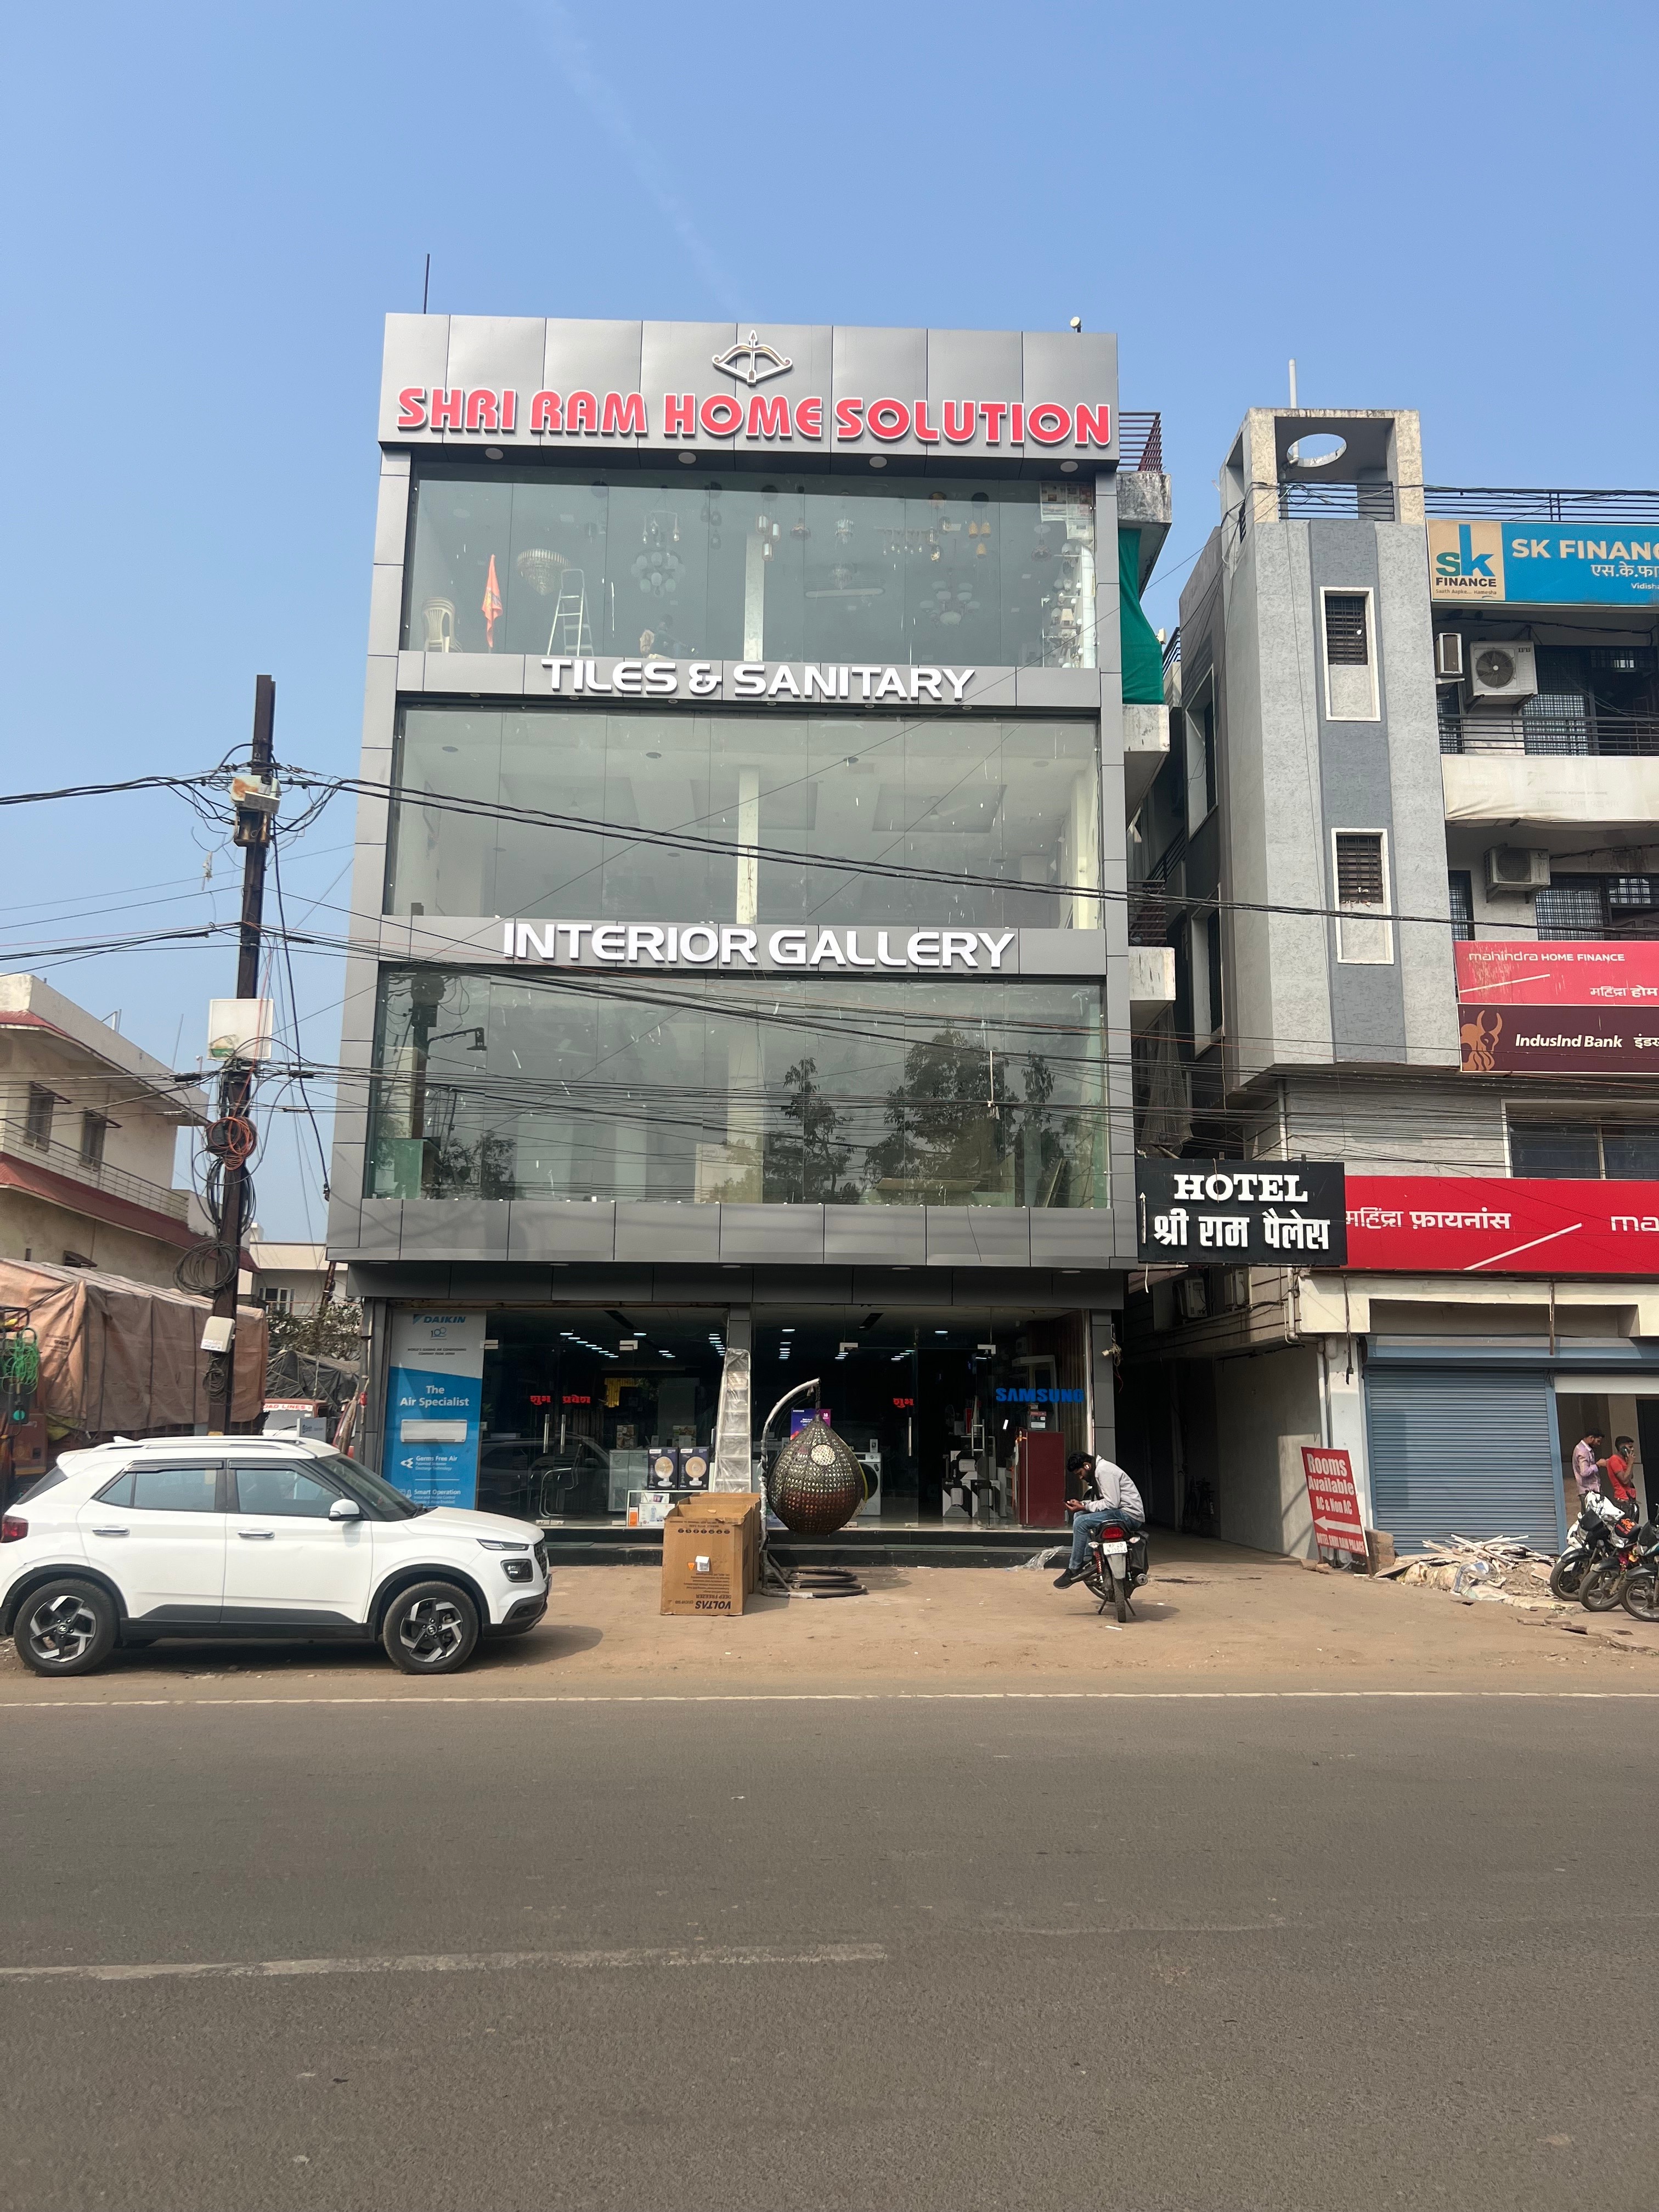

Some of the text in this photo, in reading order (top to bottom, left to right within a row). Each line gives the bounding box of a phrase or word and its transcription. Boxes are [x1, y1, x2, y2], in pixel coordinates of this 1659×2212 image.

[397, 386, 1110, 446] SHRI RAM HOME SOLUTION
[1511, 539, 1551, 558] SK
[1436, 577, 1497, 587] FINANCE
[541, 658, 975, 701] TILES & SANITARY
[504, 922, 1015, 968] INTERIOR GALLERY
[1469, 951, 1625, 962] mahindra HOME FINANCE
[1630, 985, 1658, 997] होम
[1515, 1034, 1623, 1047] IndusInd Bank
[1173, 1173, 1308, 1202] HOTEL
[1154, 1207, 1330, 1250] श्री राम पैलेस
[426, 1385, 445, 1394] The
[996, 1387, 1085, 1403] SAMSUNG
[400, 1397, 470, 1408] Air Specialist
[1307, 1453, 1347, 1477] Rooms
[1307, 1475, 1355, 1496] Available
[1316, 1496, 1325, 1511] AC
[1325, 1499, 1330, 1511] &
[1343, 1499, 1353, 1515] AC
[695, 1601, 731, 1609] VOLTAS
